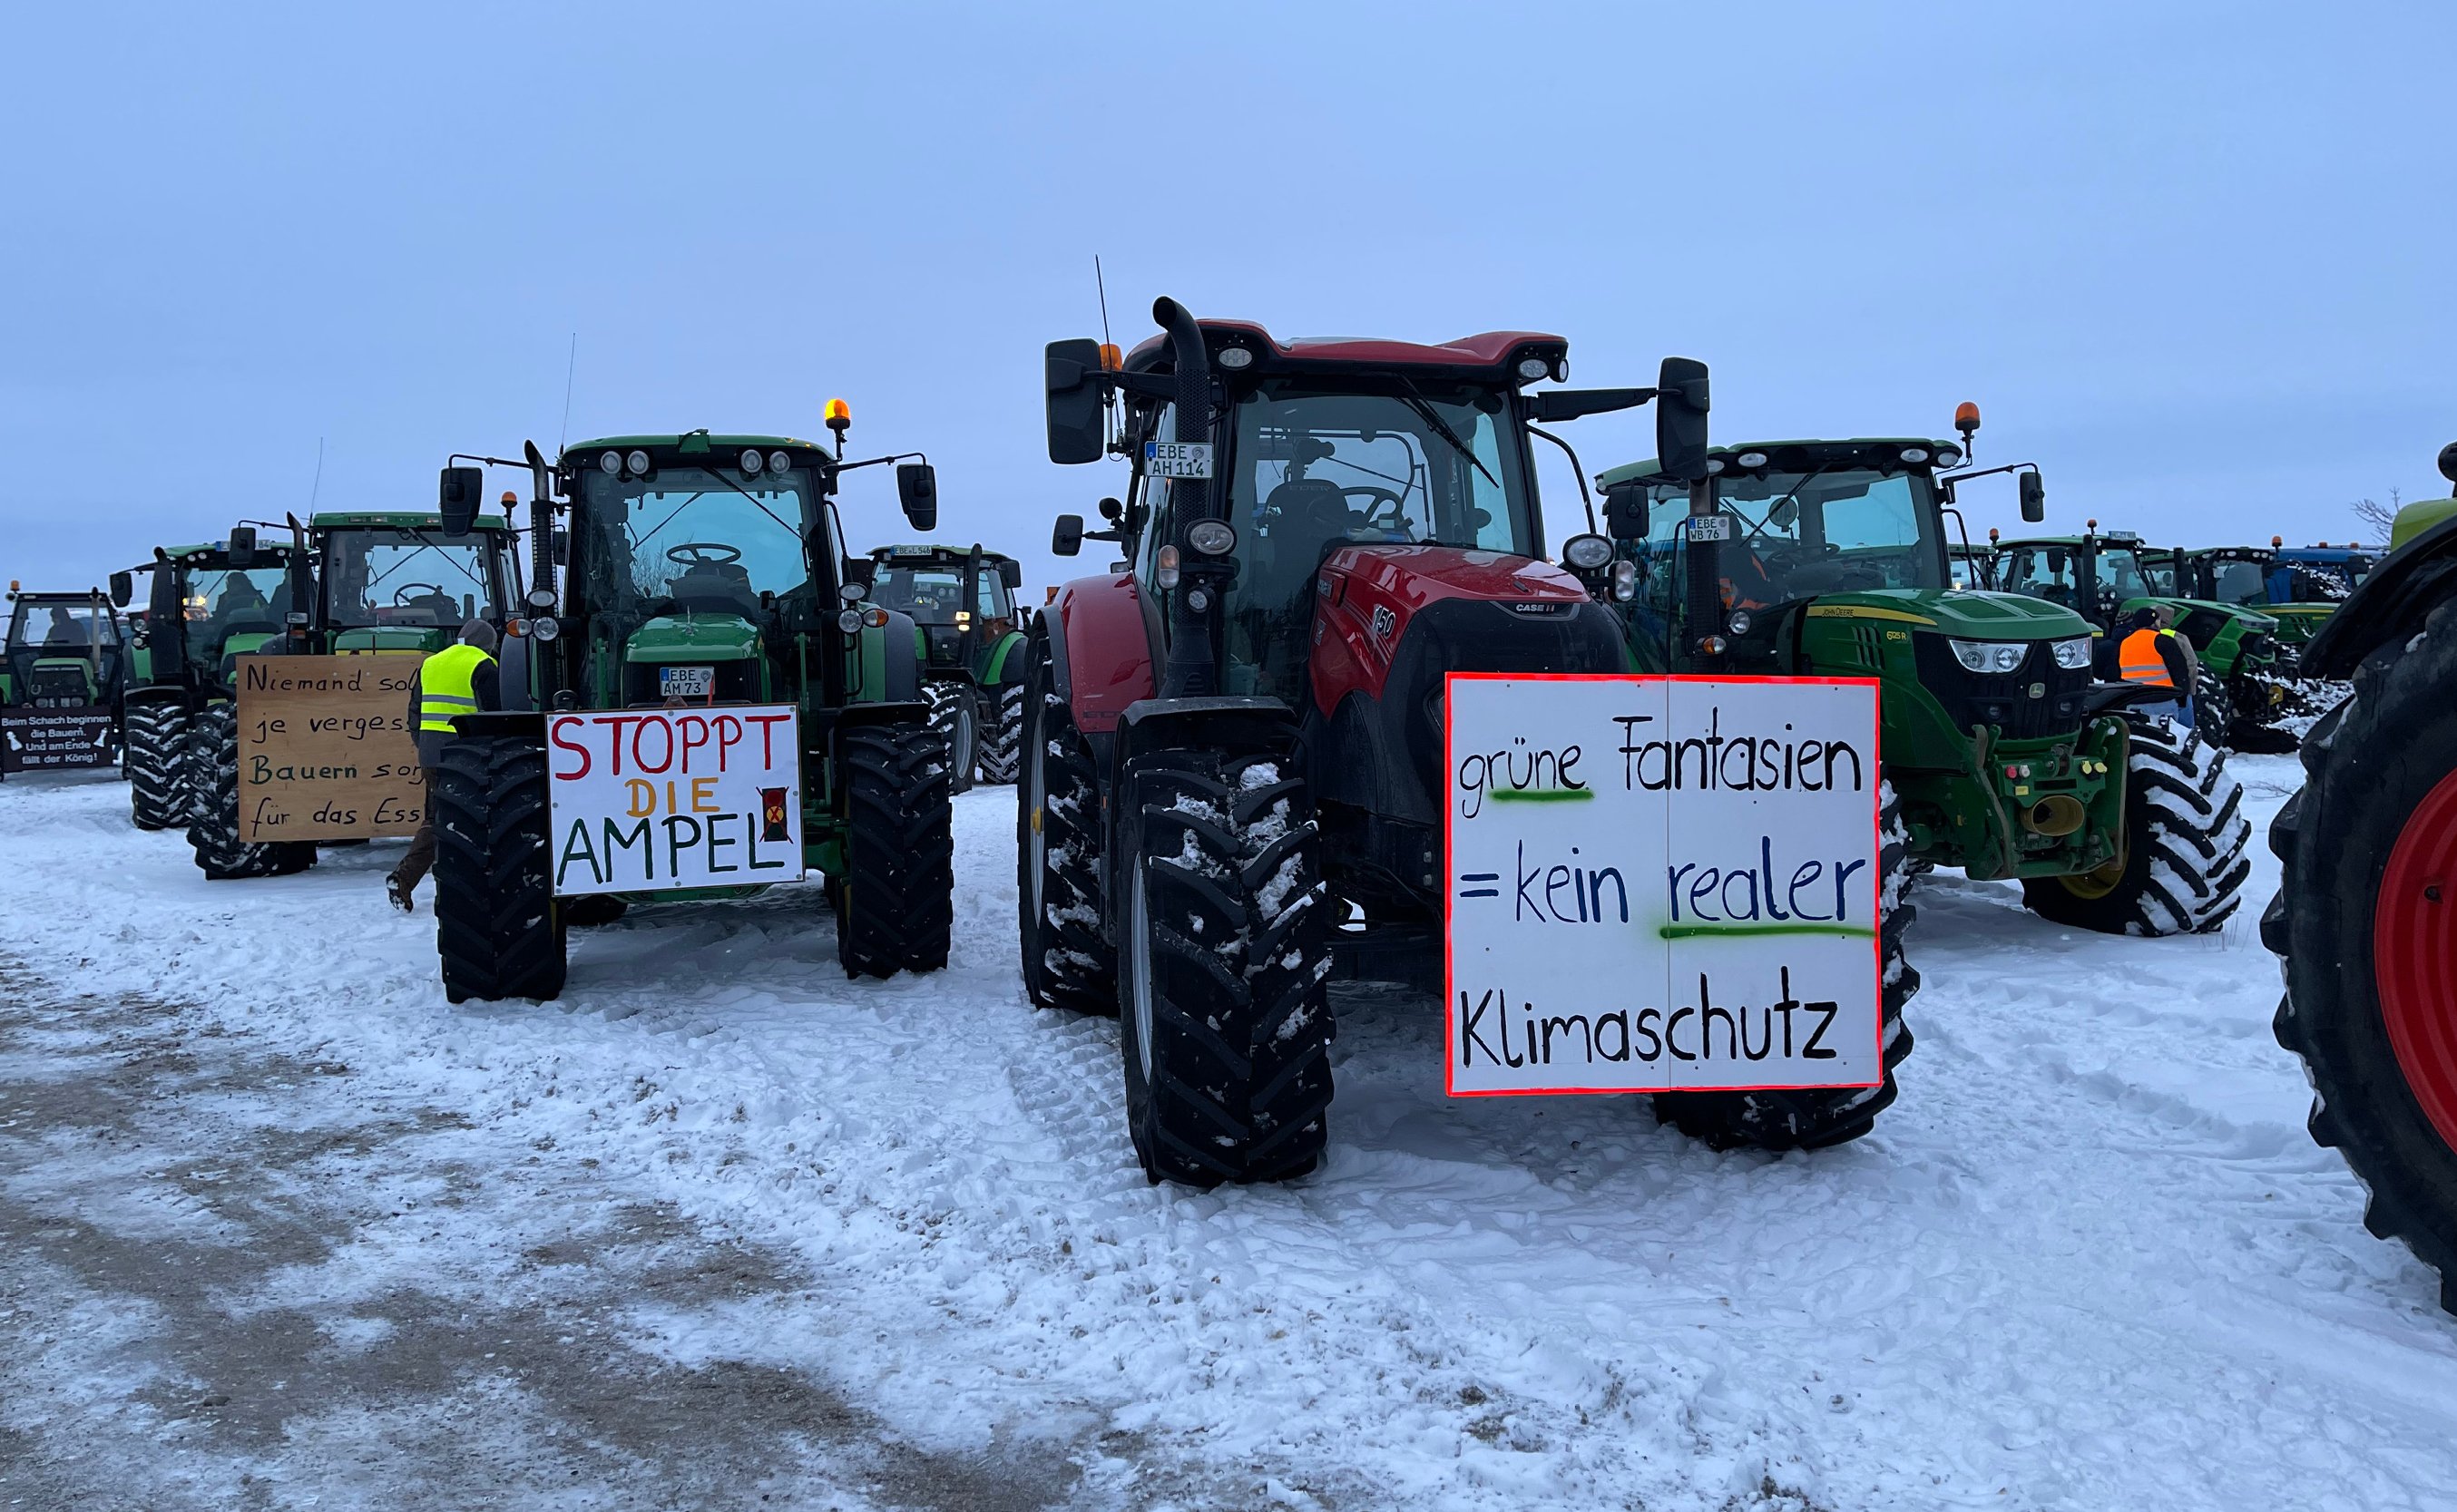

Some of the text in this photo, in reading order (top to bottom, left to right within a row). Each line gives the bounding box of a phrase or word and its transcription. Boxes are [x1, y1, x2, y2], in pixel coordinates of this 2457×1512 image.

[1157, 444, 1188, 459] EBE
[1152, 461, 1204, 476] AH 114
[1697, 519, 1718, 529] EBE
[1690, 530, 1719, 540] WB 76
[895, 546, 908, 554] EBE
[918, 546, 931, 554] 546
[1515, 603, 1545, 612] CASE
[1835, 607, 1855, 616] DEERE
[247, 664, 362, 691] Niemand
[670, 669, 697, 681] EBE
[663, 682, 701, 695] AM 73
[1, 715, 112, 727] Beim Schach beginnen
[251, 713, 286, 744] je
[30, 728, 46, 738] die
[25, 740, 92, 751] Und am Ende
[551, 714, 791, 781] STOPPT
[22, 756, 40, 765] fällt
[44, 755, 61, 764] der
[1458, 706, 1862, 819] grüne Fantasien
[248, 755, 357, 785] Bauern
[624, 777, 720, 817] DIE
[250, 797, 420, 837] für das Ess
[555, 812, 785, 887] AMPEL
[1668, 835, 1866, 922] realer
[1460, 965, 1838, 1068] Klimaschutz
